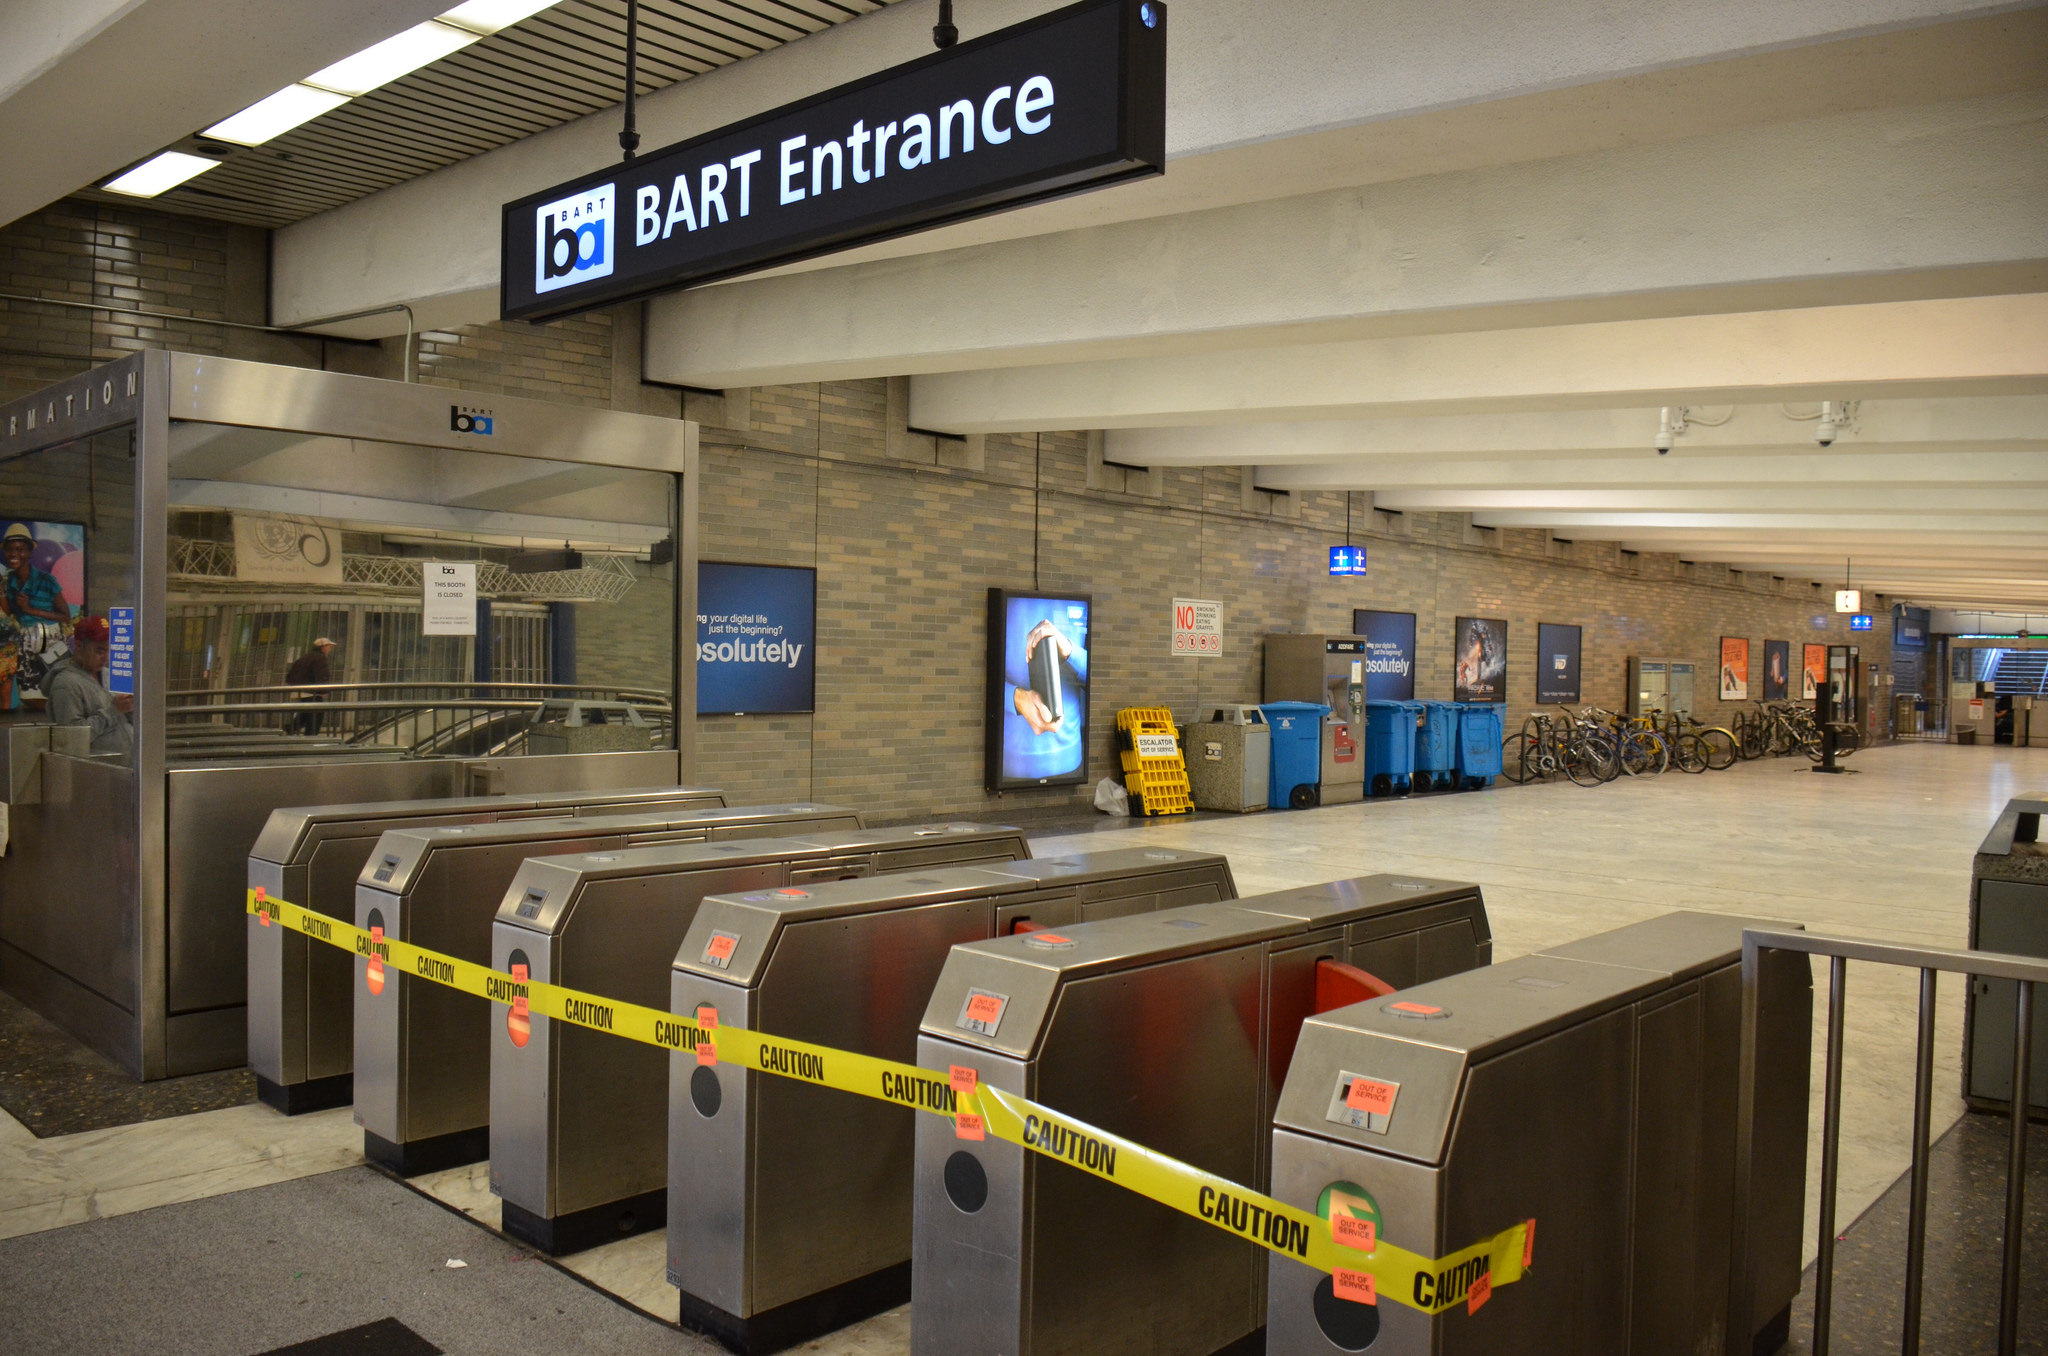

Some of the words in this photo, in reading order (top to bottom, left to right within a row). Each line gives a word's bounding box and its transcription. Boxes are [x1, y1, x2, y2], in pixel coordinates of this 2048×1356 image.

[635, 149, 760, 247] BART
[779, 75, 1054, 205] Entrance
[562, 198, 605, 222] BART
[710, 615, 728, 624] your
[730, 614, 754, 625] digital
[756, 614, 767, 624] life
[1176, 605, 1195, 630] NO
[709, 625, 724, 635] just
[725, 625, 739, 634] the
[741, 625, 783, 636] beginning?
[302, 915, 332, 940] CAUTION
[418, 955, 455, 984] CAUTION
[487, 976, 528, 1002] CAUTION
[565, 998, 613, 1030] CAUTION
[655, 1020, 710, 1051] CAUTION
[760, 1044, 824, 1081] CAUTION
[954, 1075, 973, 1084] SERVICE
[1360, 1084, 1375, 1092] OUT
[882, 1071, 957, 1113] CAUTION
[1356, 1090, 1387, 1103] SERVICE
[960, 1122, 980, 1130] SERVICE
[1022, 1114, 1117, 1177] CAUTION
[1198, 1185, 1310, 1257] CAUTION
[1338, 1226, 1370, 1239] SERVICE
[1340, 1220, 1355, 1228] OUT
[1358, 1223, 1368, 1231] OF
[1339, 1279, 1370, 1292] SERVICE
[1340, 1272, 1355, 1281] OUT
[1358, 1276, 1368, 1284] OF
